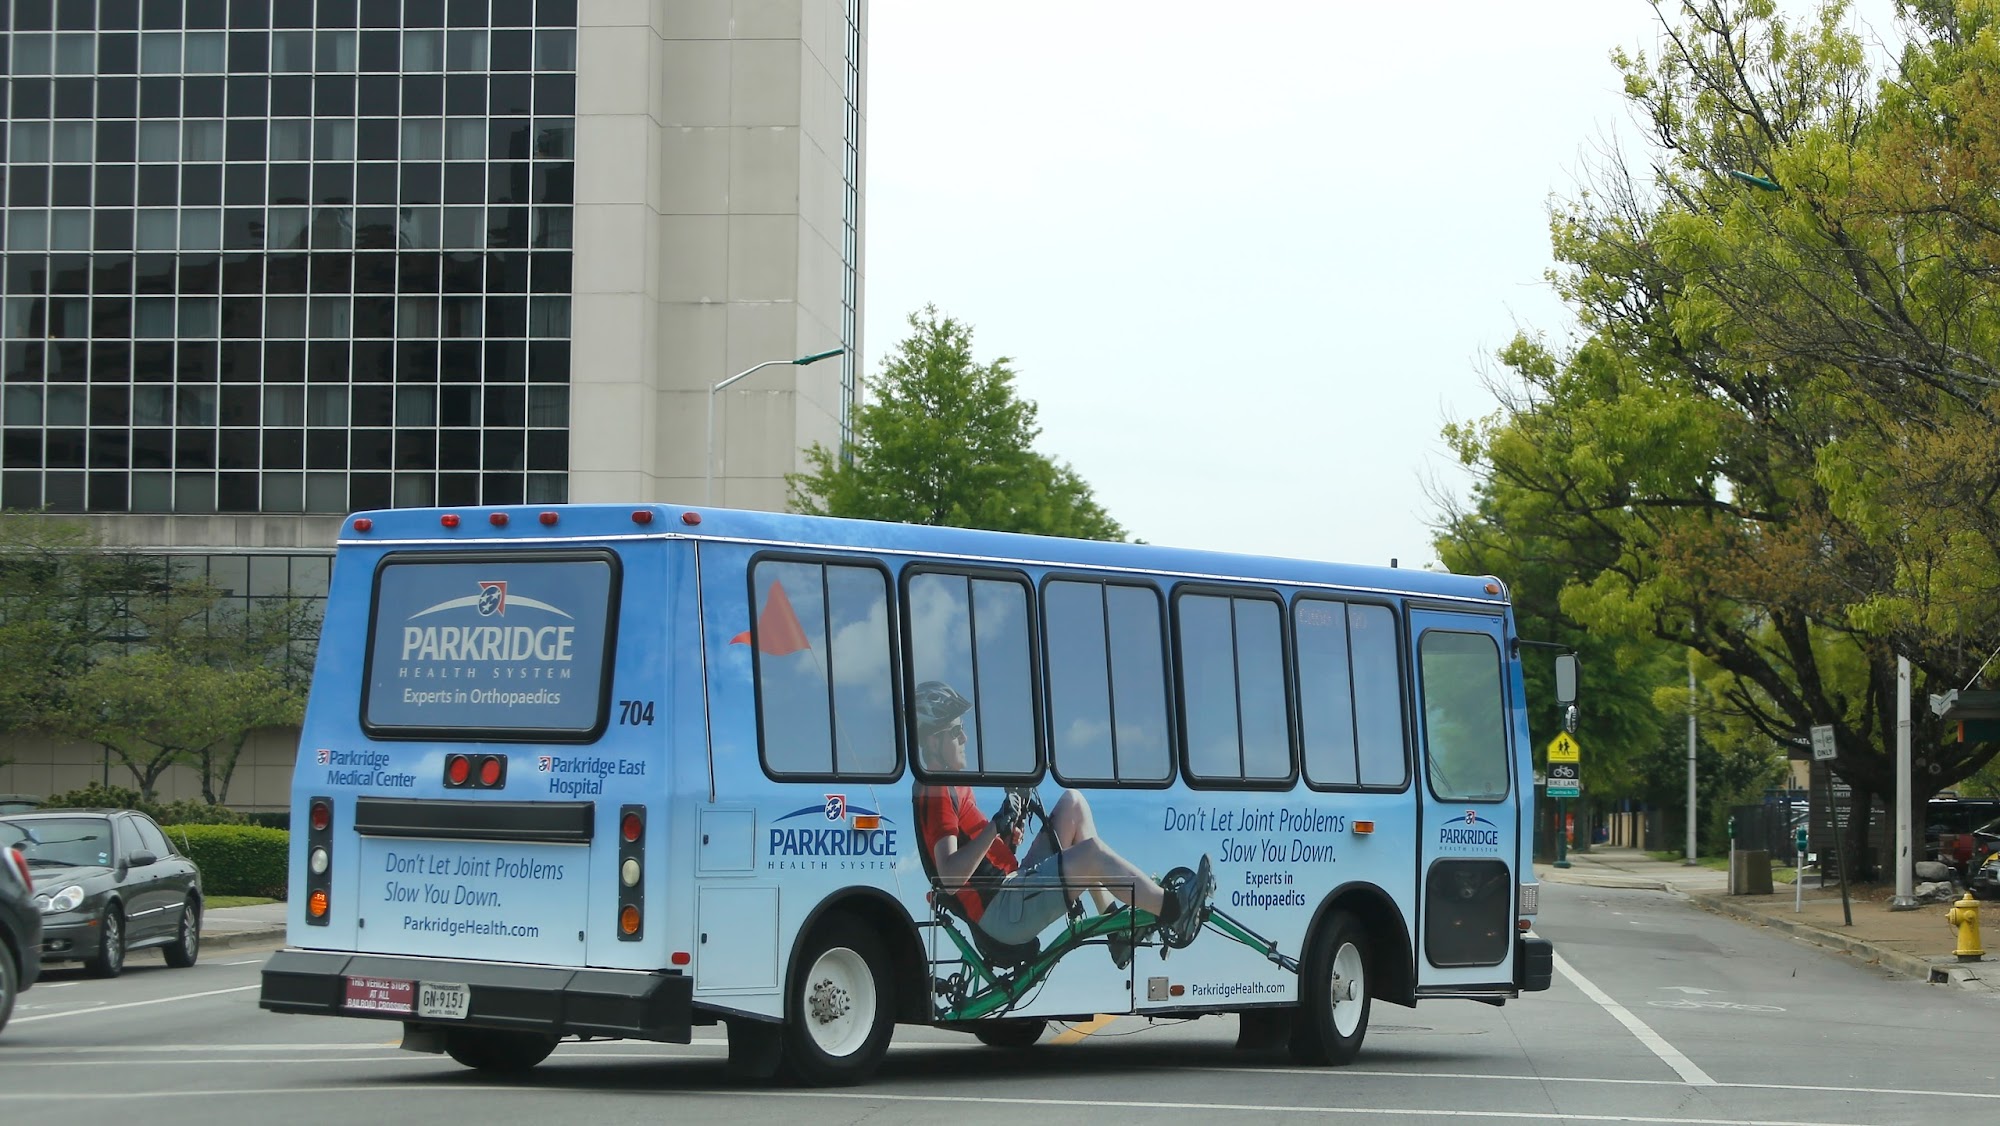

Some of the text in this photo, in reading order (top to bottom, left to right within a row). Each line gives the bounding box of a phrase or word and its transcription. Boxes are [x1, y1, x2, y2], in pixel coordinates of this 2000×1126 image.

[402, 626, 575, 661] PARKRIDGE
[399, 667, 571, 679] HEALTH SYSTEM
[403, 688, 560, 706] Experts in Orthopaedics
[619, 700, 654, 726] 704
[330, 750, 389, 771] Parkridge
[551, 757, 646, 778] Parkridge East
[327, 770, 416, 787] Medical Center
[549, 778, 603, 798] Hospital
[1164, 806, 1345, 833] Don't Let Joint Problems
[769, 829, 897, 856] PARKRIDGE
[1440, 828, 1498, 845] PARKRIDGE
[1220, 838, 1336, 863] Slow You Down.
[385, 852, 564, 880] Don't Let Joint Problems
[768, 861, 897, 869] HEALTH SYSTEM
[1245, 871, 1293, 888] Experts in
[384, 881, 501, 907] Slow You Down.
[1232, 890, 1305, 910] Orthopaedics
[403, 916, 539, 938] ParkridgeHealth.com
[351, 978, 410, 991] THIS VEHICLE STOPS
[369, 989, 390, 1000] AT ALL
[1192, 982, 1285, 998] ParkridgeHealth.com
[347, 998, 377, 1009] RAILROAD
